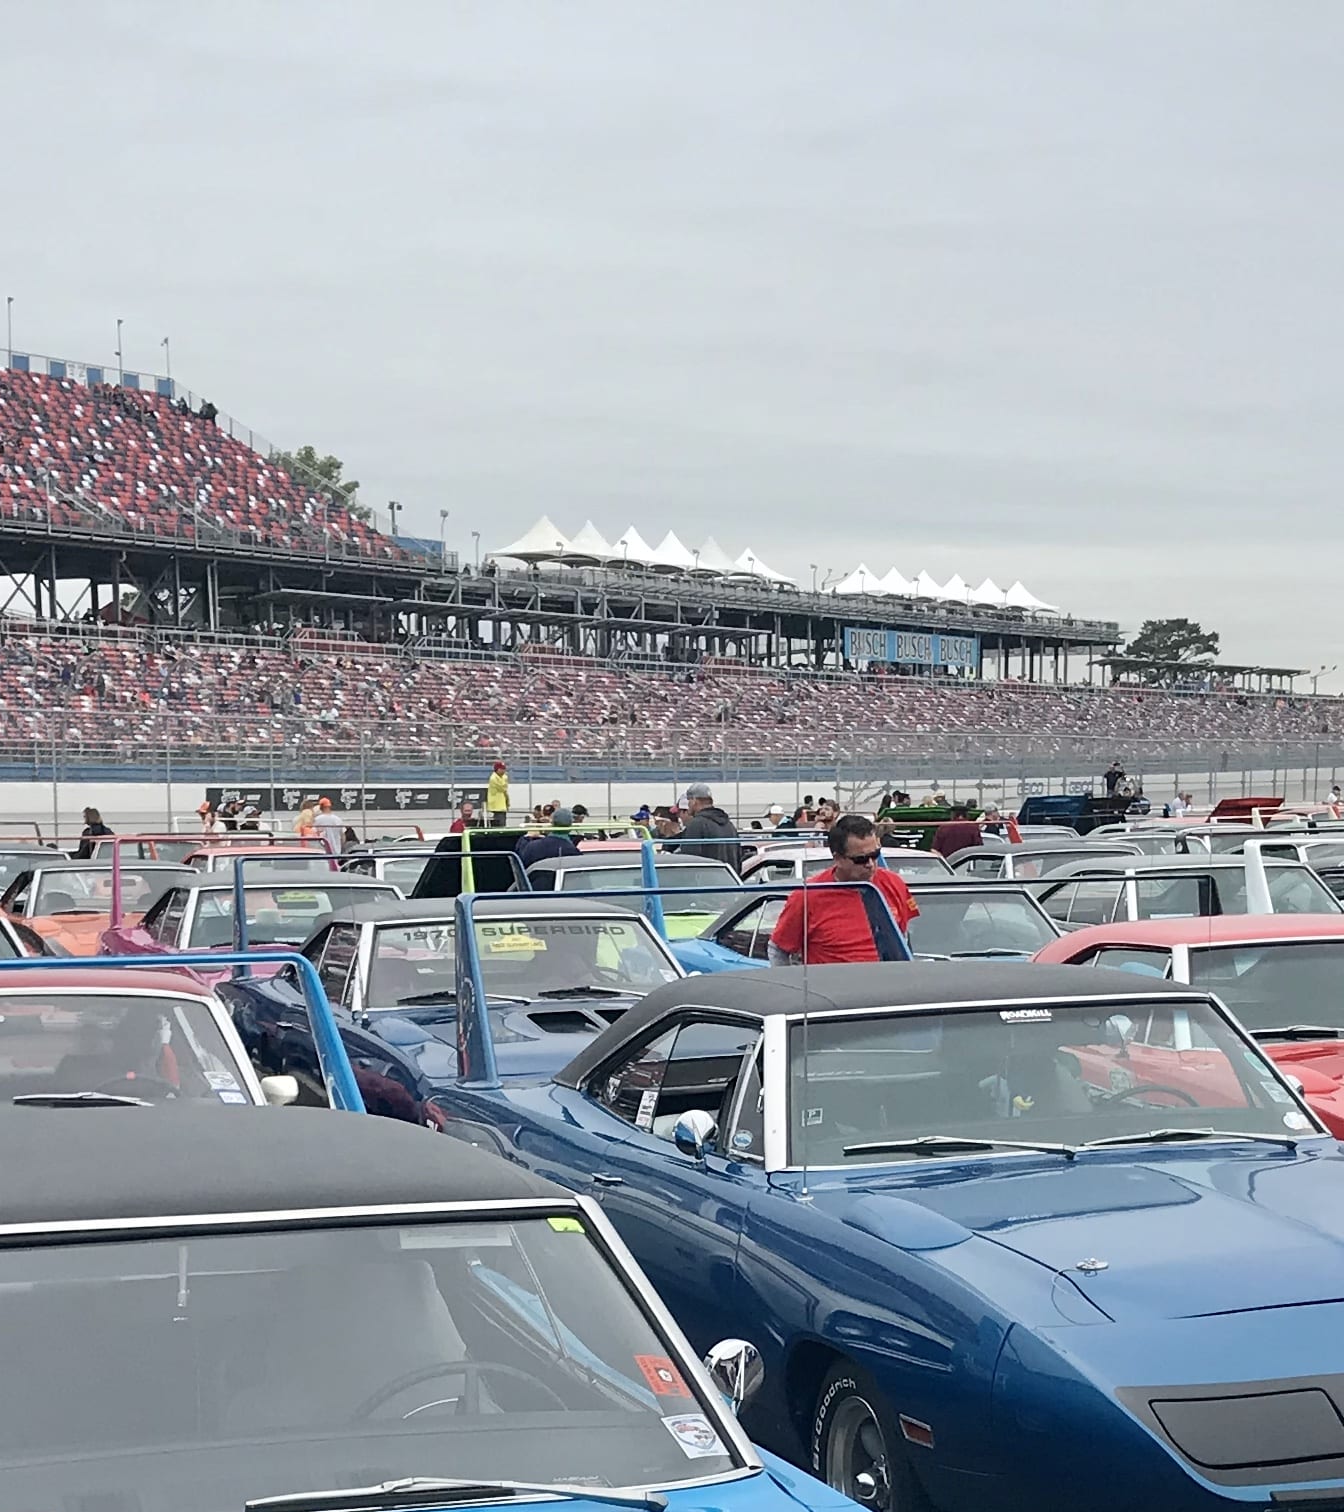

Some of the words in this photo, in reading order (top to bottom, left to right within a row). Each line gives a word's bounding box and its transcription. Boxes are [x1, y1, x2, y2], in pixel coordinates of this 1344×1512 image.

[850, 631, 887, 658] BUSCH
[896, 634, 931, 660] BUSCH
[940, 638, 972, 662] BUSCH
[481, 924, 625, 937] SUPERBIRD
